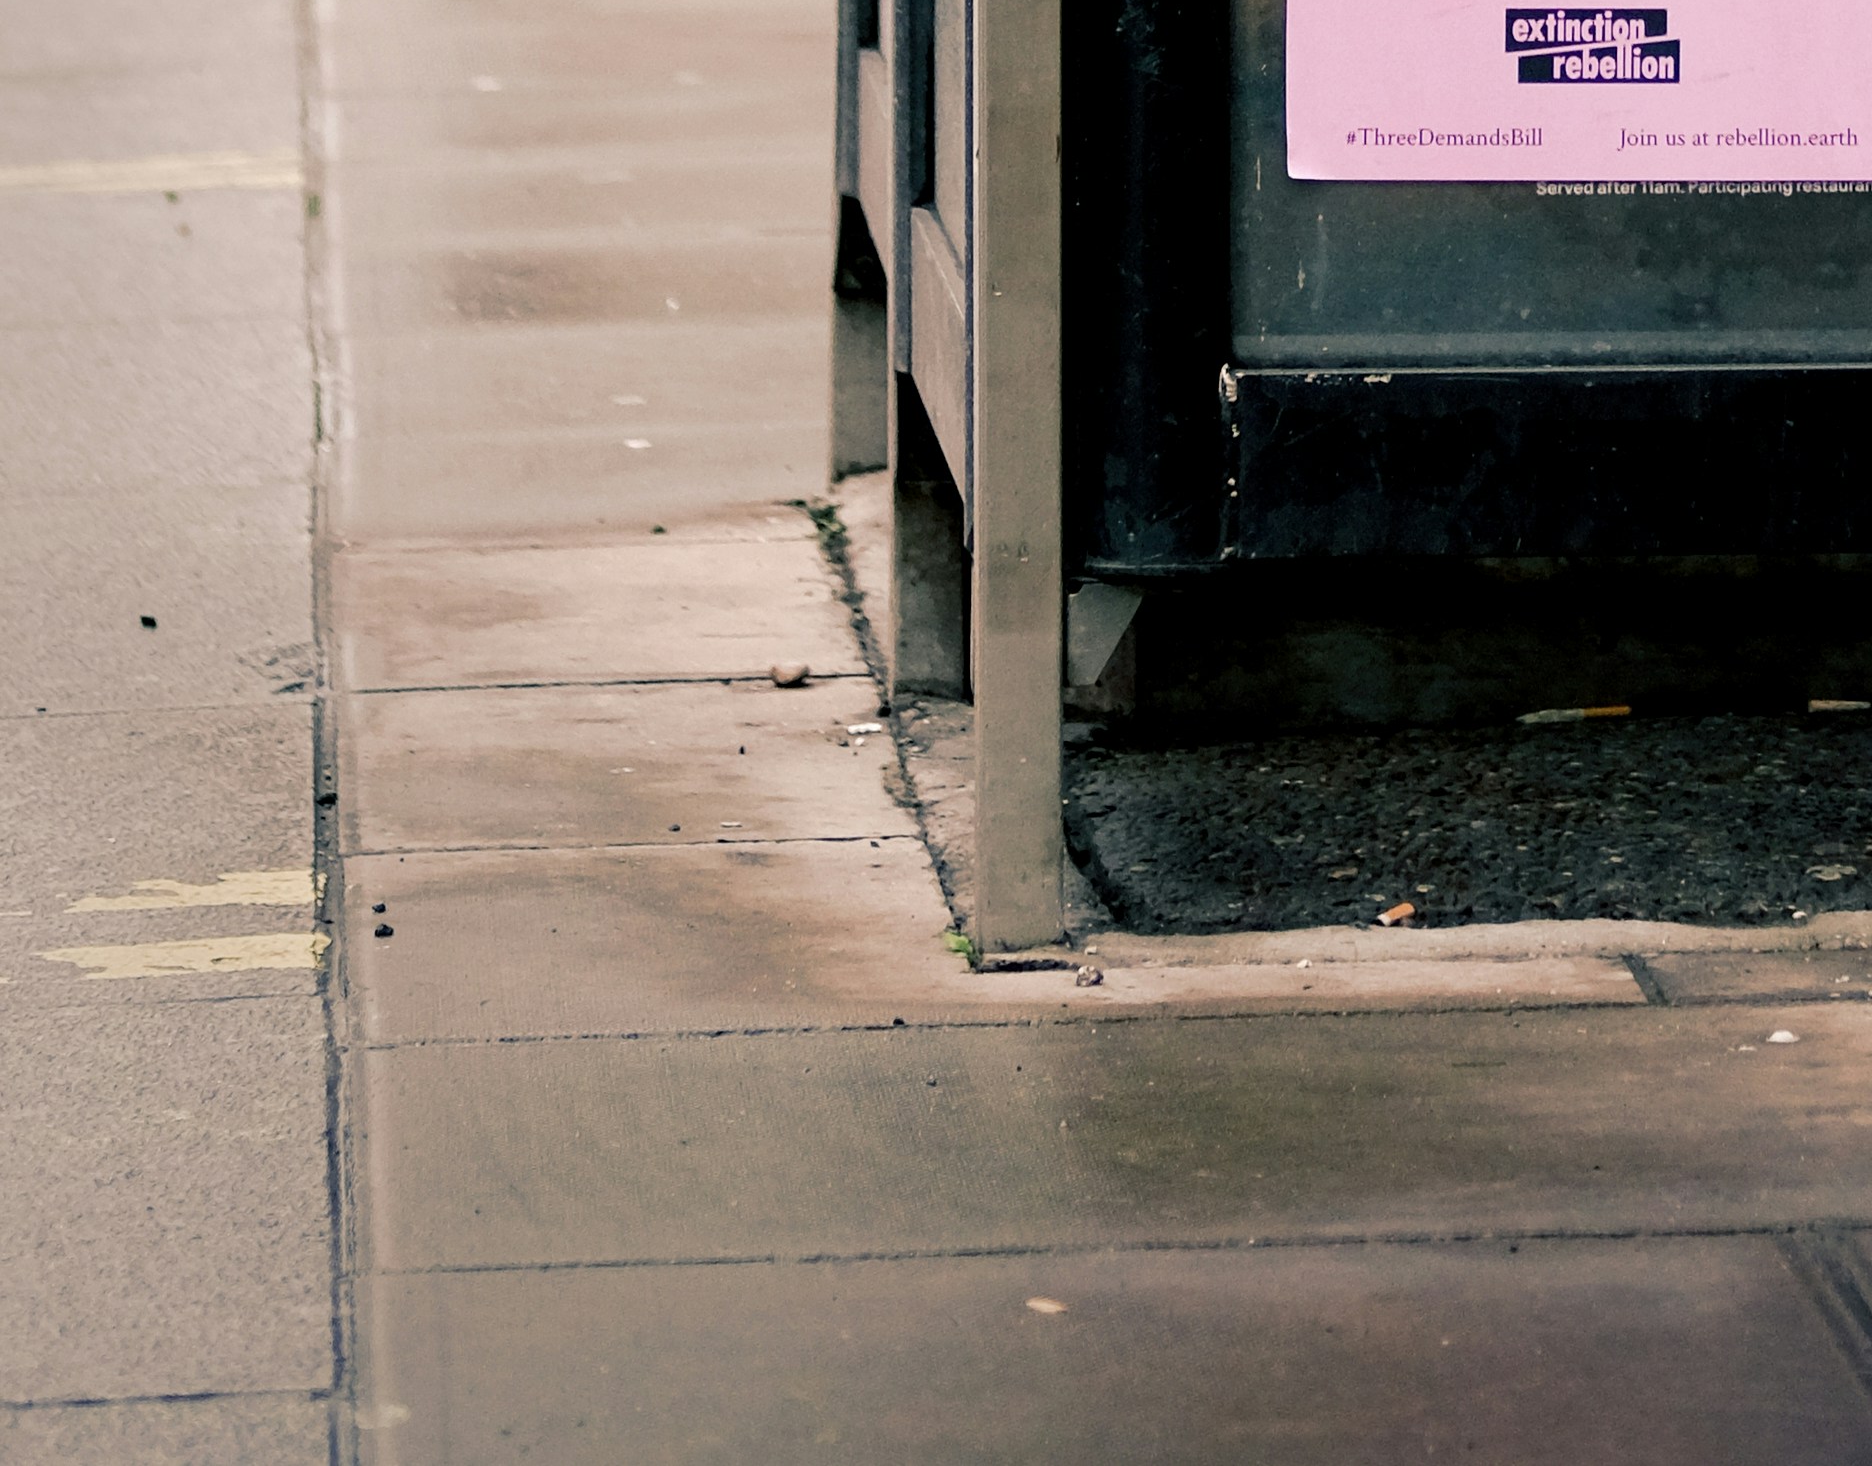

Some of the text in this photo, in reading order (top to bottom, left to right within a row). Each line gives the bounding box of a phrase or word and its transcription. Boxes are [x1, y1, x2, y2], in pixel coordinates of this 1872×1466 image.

[1511, 13, 1646, 43] extinction
[1551, 43, 1675, 81] rebellion
[1345, 127, 1544, 148] #ThreeDemandsBill
[1616, 127, 1859, 152] Join us at rebellion.earth
[1535, 180, 1595, 196] Served
[1596, 180, 1637, 195] after
